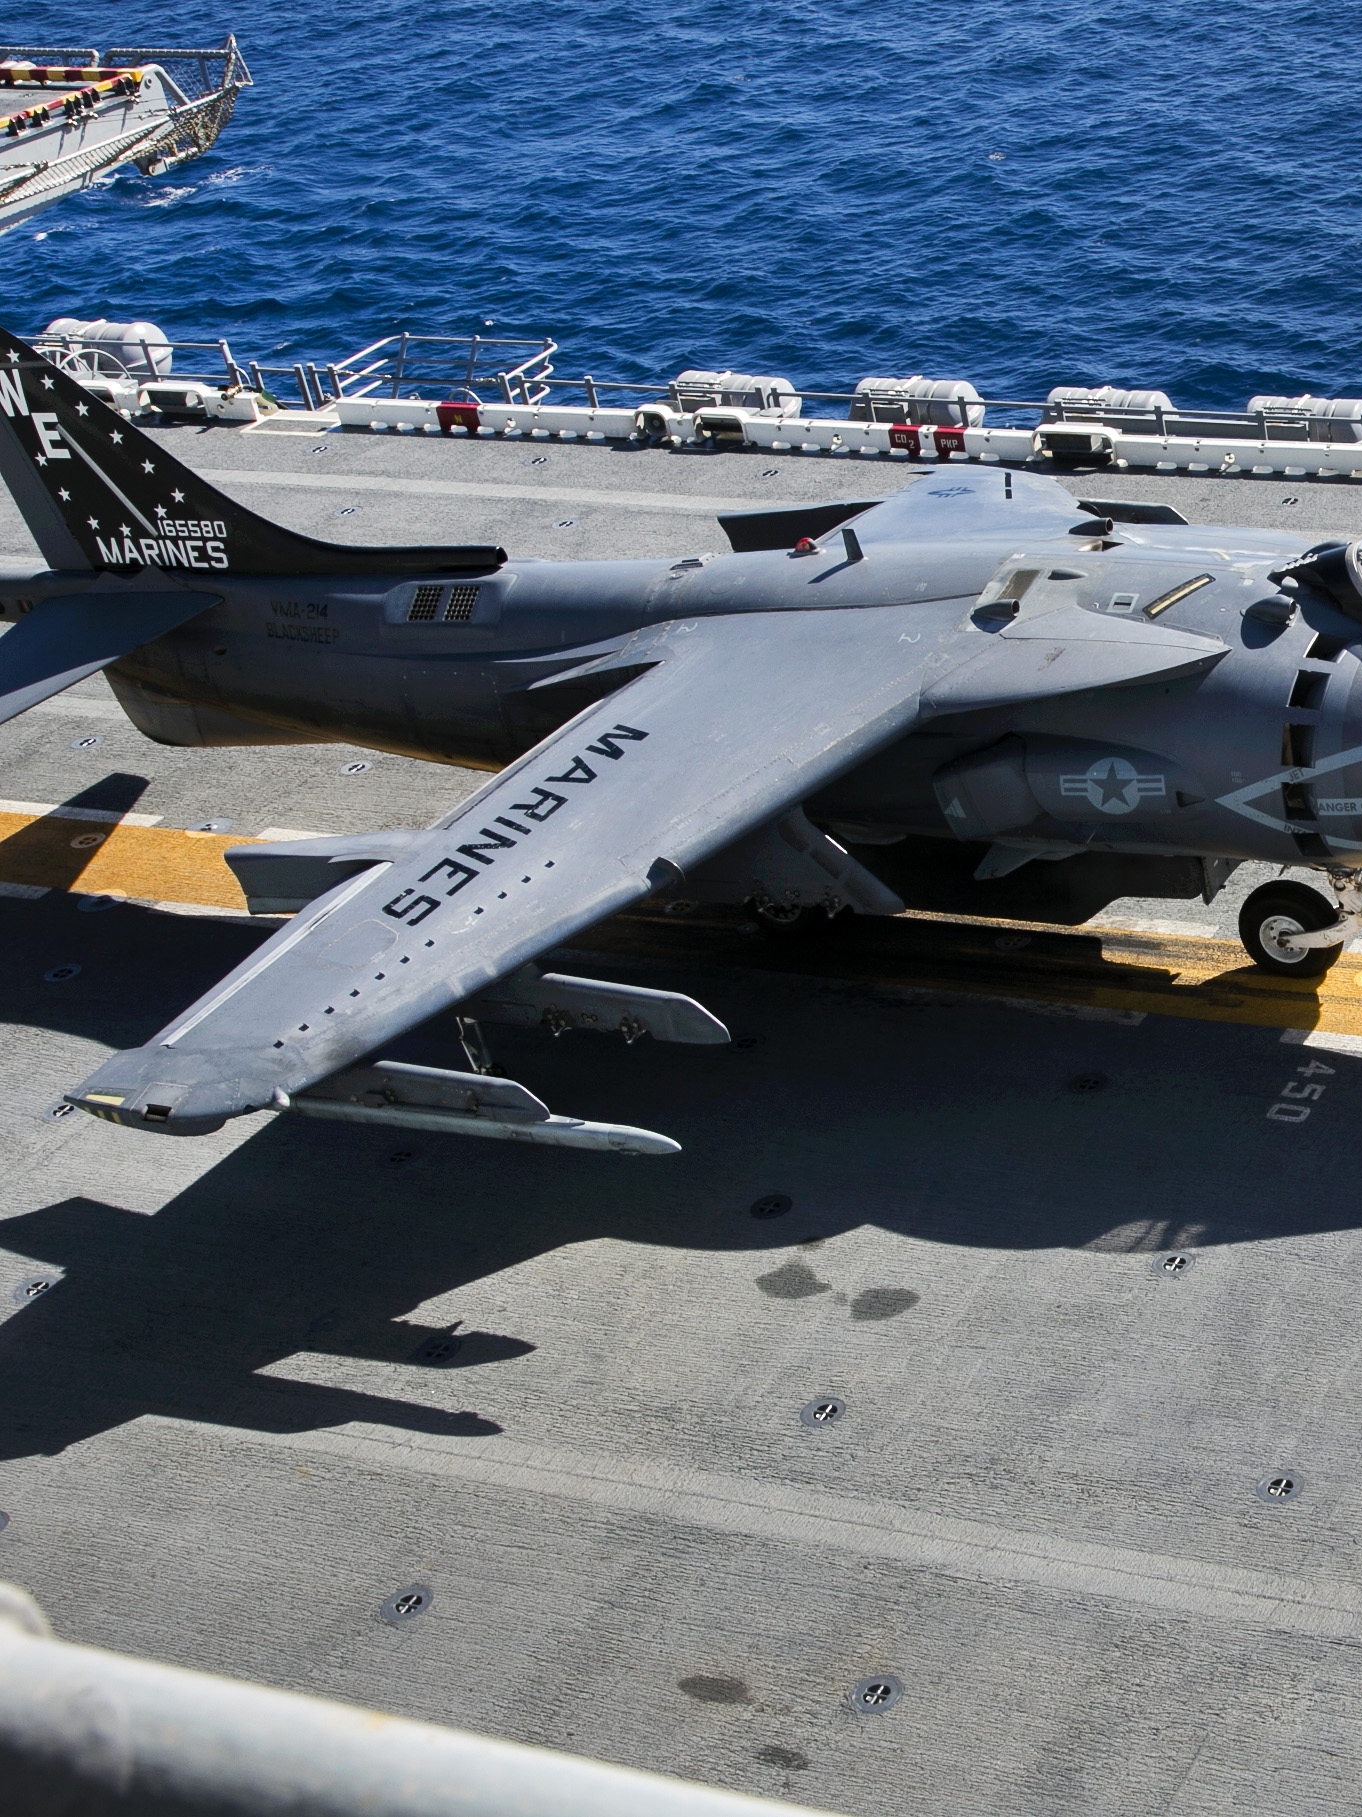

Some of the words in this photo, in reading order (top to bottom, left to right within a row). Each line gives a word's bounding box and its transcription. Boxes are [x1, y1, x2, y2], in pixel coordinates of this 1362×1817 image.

[940, 439, 958, 449] PKP
[158, 520, 228, 538] 165580
[95, 536, 230, 569] MARINES
[269, 600, 329, 620] VMA-214
[1288, 768, 1305, 782] JET
[1317, 802, 1358, 812] ANGER
[382, 723, 650, 927] MARINES
[1266, 1059, 1336, 1123] 450
